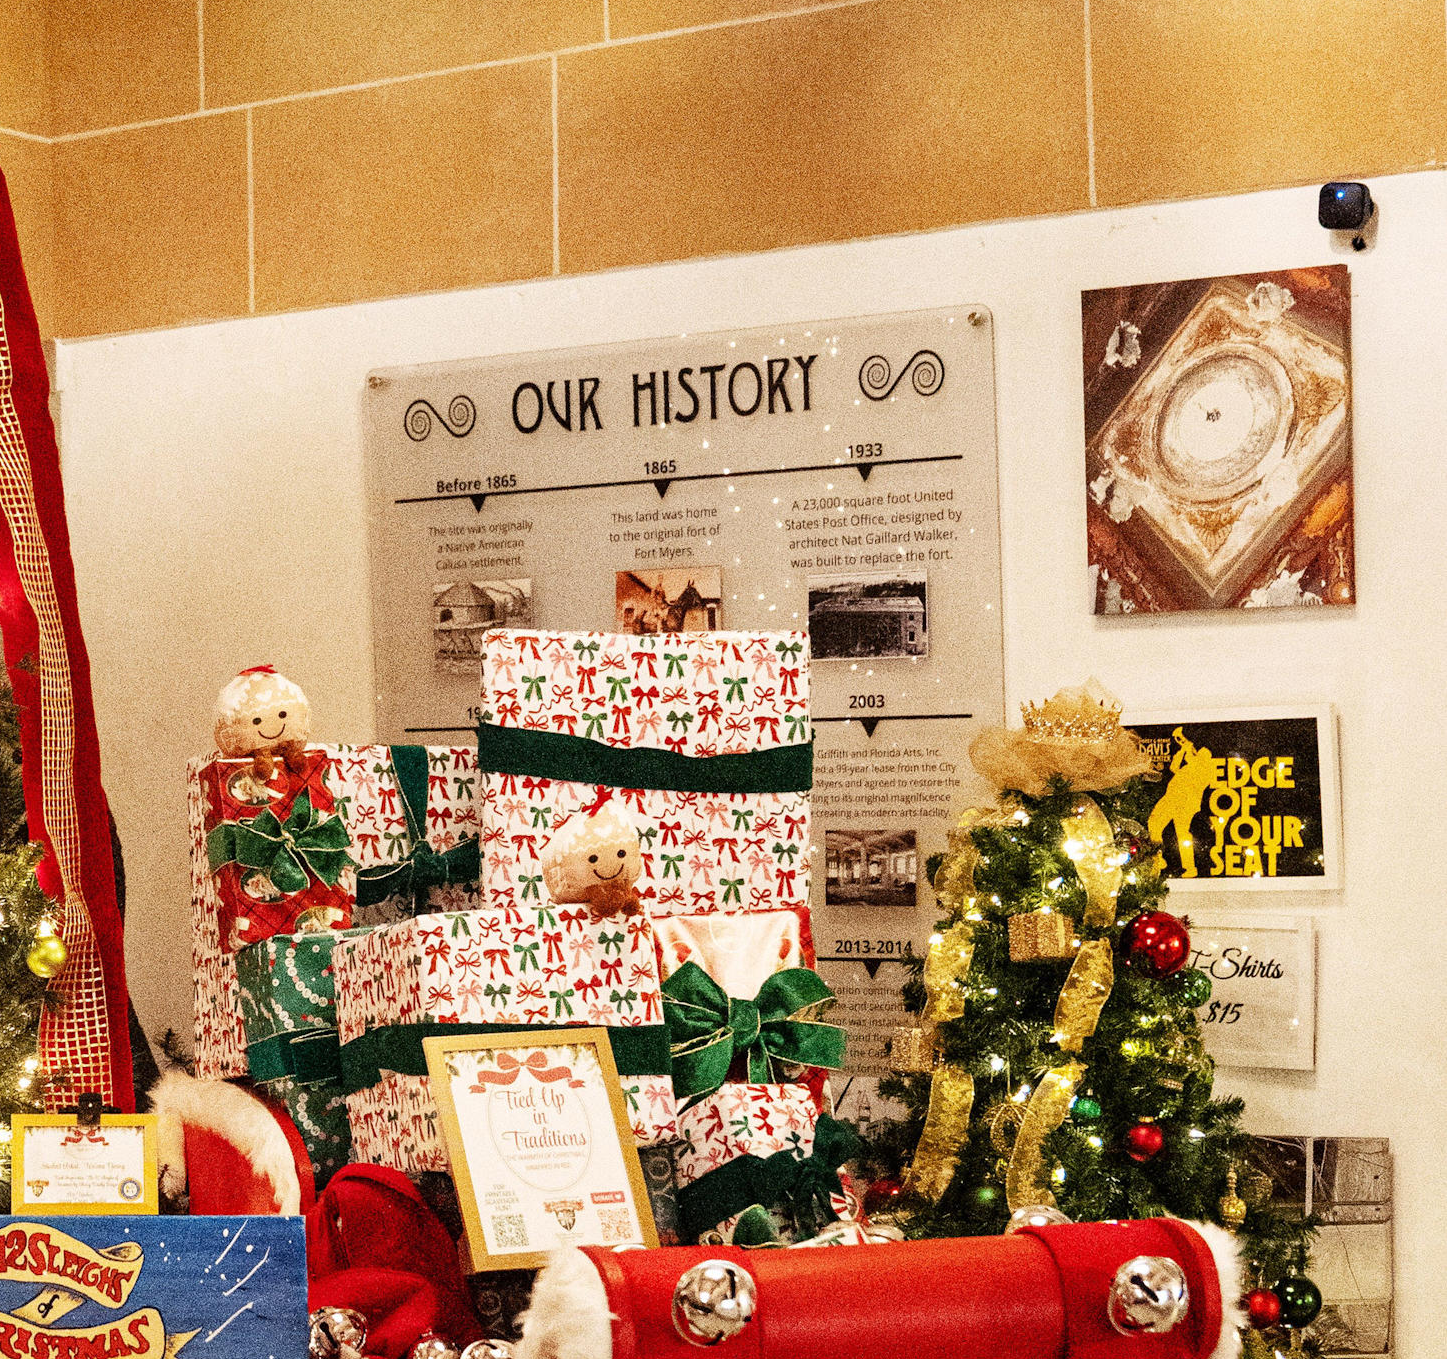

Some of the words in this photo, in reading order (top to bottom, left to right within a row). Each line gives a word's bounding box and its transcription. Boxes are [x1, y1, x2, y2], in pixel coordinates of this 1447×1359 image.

[512, 377, 603, 434] OUR
[632, 354, 818, 427] HISTORY
[848, 443, 883, 458] 1933
[644, 460, 677, 475] 1865
[436, 477, 481, 493] Before
[486, 475, 517, 489] 1865
[791, 501, 800, 511] A
[803, 497, 841, 512] 23,000
[844, 494, 884, 509] square
[887, 492, 911, 504] foot
[914, 489, 954, 502] United
[611, 513, 633, 523] This
[636, 510, 659, 521] land
[661, 511, 683, 520] was
[687, 507, 718, 519] home
[785, 519, 819, 531] States
[823, 516, 847, 528] Post
[850, 513, 888, 526] Office,
[891, 509, 944, 525] designed
[948, 508, 962, 522] by
[428, 527, 446, 537] The
[468, 525, 486, 534] was
[489, 520, 533, 535] originally
[609, 532, 620, 542] to
[623, 530, 641, 541] the
[643, 527, 683, 542] original
[687, 526, 706, 537] fort
[709, 523, 721, 535] of
[445, 542, 476, 552] Native
[479, 539, 524, 550] American
[789, 536, 838, 550] architect
[842, 534, 862, 546] Nat
[865, 531, 910, 544] Gaillard
[635, 548, 656, 559] Fort
[659, 547, 695, 560] Myers.
[790, 558, 813, 568] was
[816, 554, 842, 566] built
[844, 555, 856, 565] to
[860, 552, 902, 565] replace
[905, 550, 924, 561] the
[929, 548, 954, 560] fort.
[849, 694, 885, 709] 2003
[817, 749, 848, 759] Griffith
[851, 749, 868, 758] and
[870, 749, 901, 758] Florida
[903, 748, 923, 758] Arts,
[1139, 743, 1171, 756] DAVIS
[836, 764, 870, 776] 99-year
[872, 763, 895, 773] lease
[897, 763, 919, 772] from
[921, 763, 937, 772] the
[939, 762, 957, 773] City
[1210, 756, 1294, 788] EDGE
[816, 779, 843, 790] Myers
[845, 779, 862, 788] and
[864, 778, 895, 790] agreed
[898, 779, 908, 787] to
[945, 777, 961, 786] the
[854, 794, 888, 805] original
[891, 793, 951, 805] magnificence
[1209, 786, 1258, 815] OF
[901, 809, 917, 817] arts
[1210, 814, 1303, 848] YOUR
[1209, 845, 1281, 877] SEAT
[835, 940, 913, 954] 2013-2014
[1191, 948, 1284, 979] T-Shirts
[1202, 1001, 1244, 1025] $15
[495, 1086, 536, 1110] Tied
[540, 1086, 565, 1115] Up
[533, 1108, 548, 1125] in
[501, 1127, 587, 1151] Traditions
[28, 1232, 134, 1303] SLEIGHS
[37, 1294, 60, 1318] of
